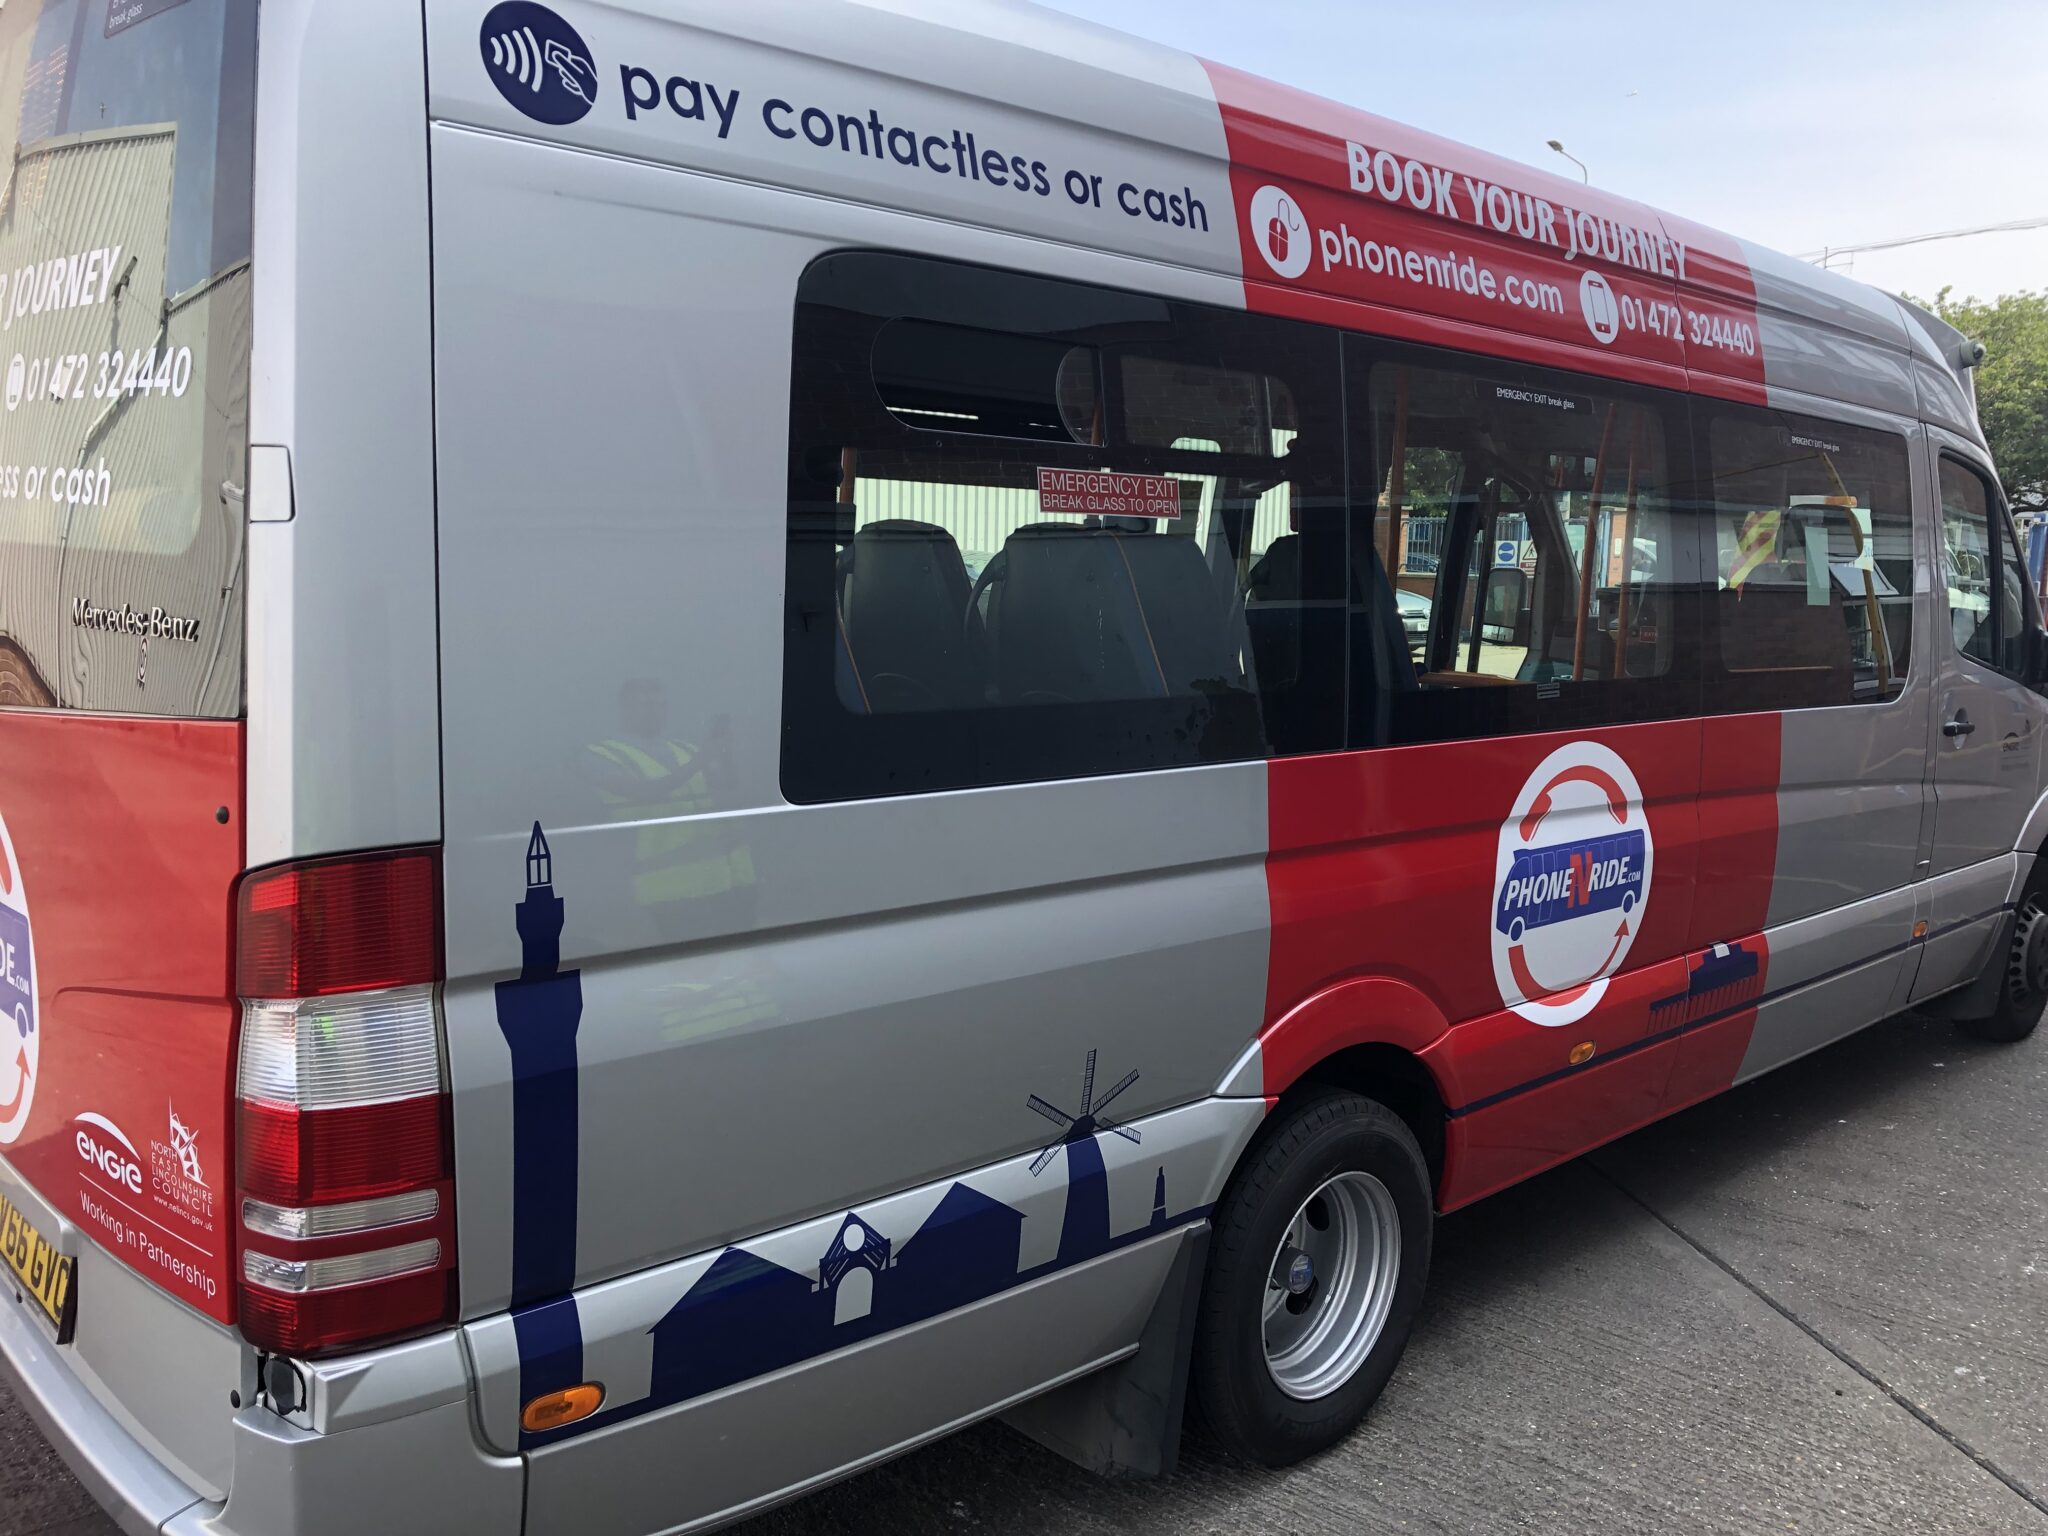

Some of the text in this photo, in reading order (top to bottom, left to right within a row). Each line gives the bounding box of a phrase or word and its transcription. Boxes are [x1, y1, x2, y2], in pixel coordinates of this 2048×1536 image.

[619, 64, 1209, 232] pay contactless or cash
[1345, 140, 1686, 280] BOOK YOUR JOURNEY
[4, 245, 122, 331] JOURNEY
[1318, 223, 1564, 314] phonenride.com
[1621, 294, 1755, 356] 01472 324440
[27, 346, 192, 402] 01472 324440
[1496, 387, 1575, 410] EMERGENCY EXIT break glass
[25, 465, 47, 500] or
[51, 456, 111, 507] cash
[1040, 471, 1176, 498] EMERGENCY EXIT
[1042, 493, 1178, 514] BREAK GLASS TO OPEN
[72, 597, 200, 642] Mercedes-Benz
[150, 1139, 178, 1162] NORTH
[151, 1152, 178, 1174] EAST
[151, 1163, 213, 1205] LINCOLNSHIRE
[152, 1177, 213, 1218] COUNCIL
[153, 1194, 214, 1233] www.nelincs.gov.uk
[80, 1189, 216, 1300] Working in Partnership
